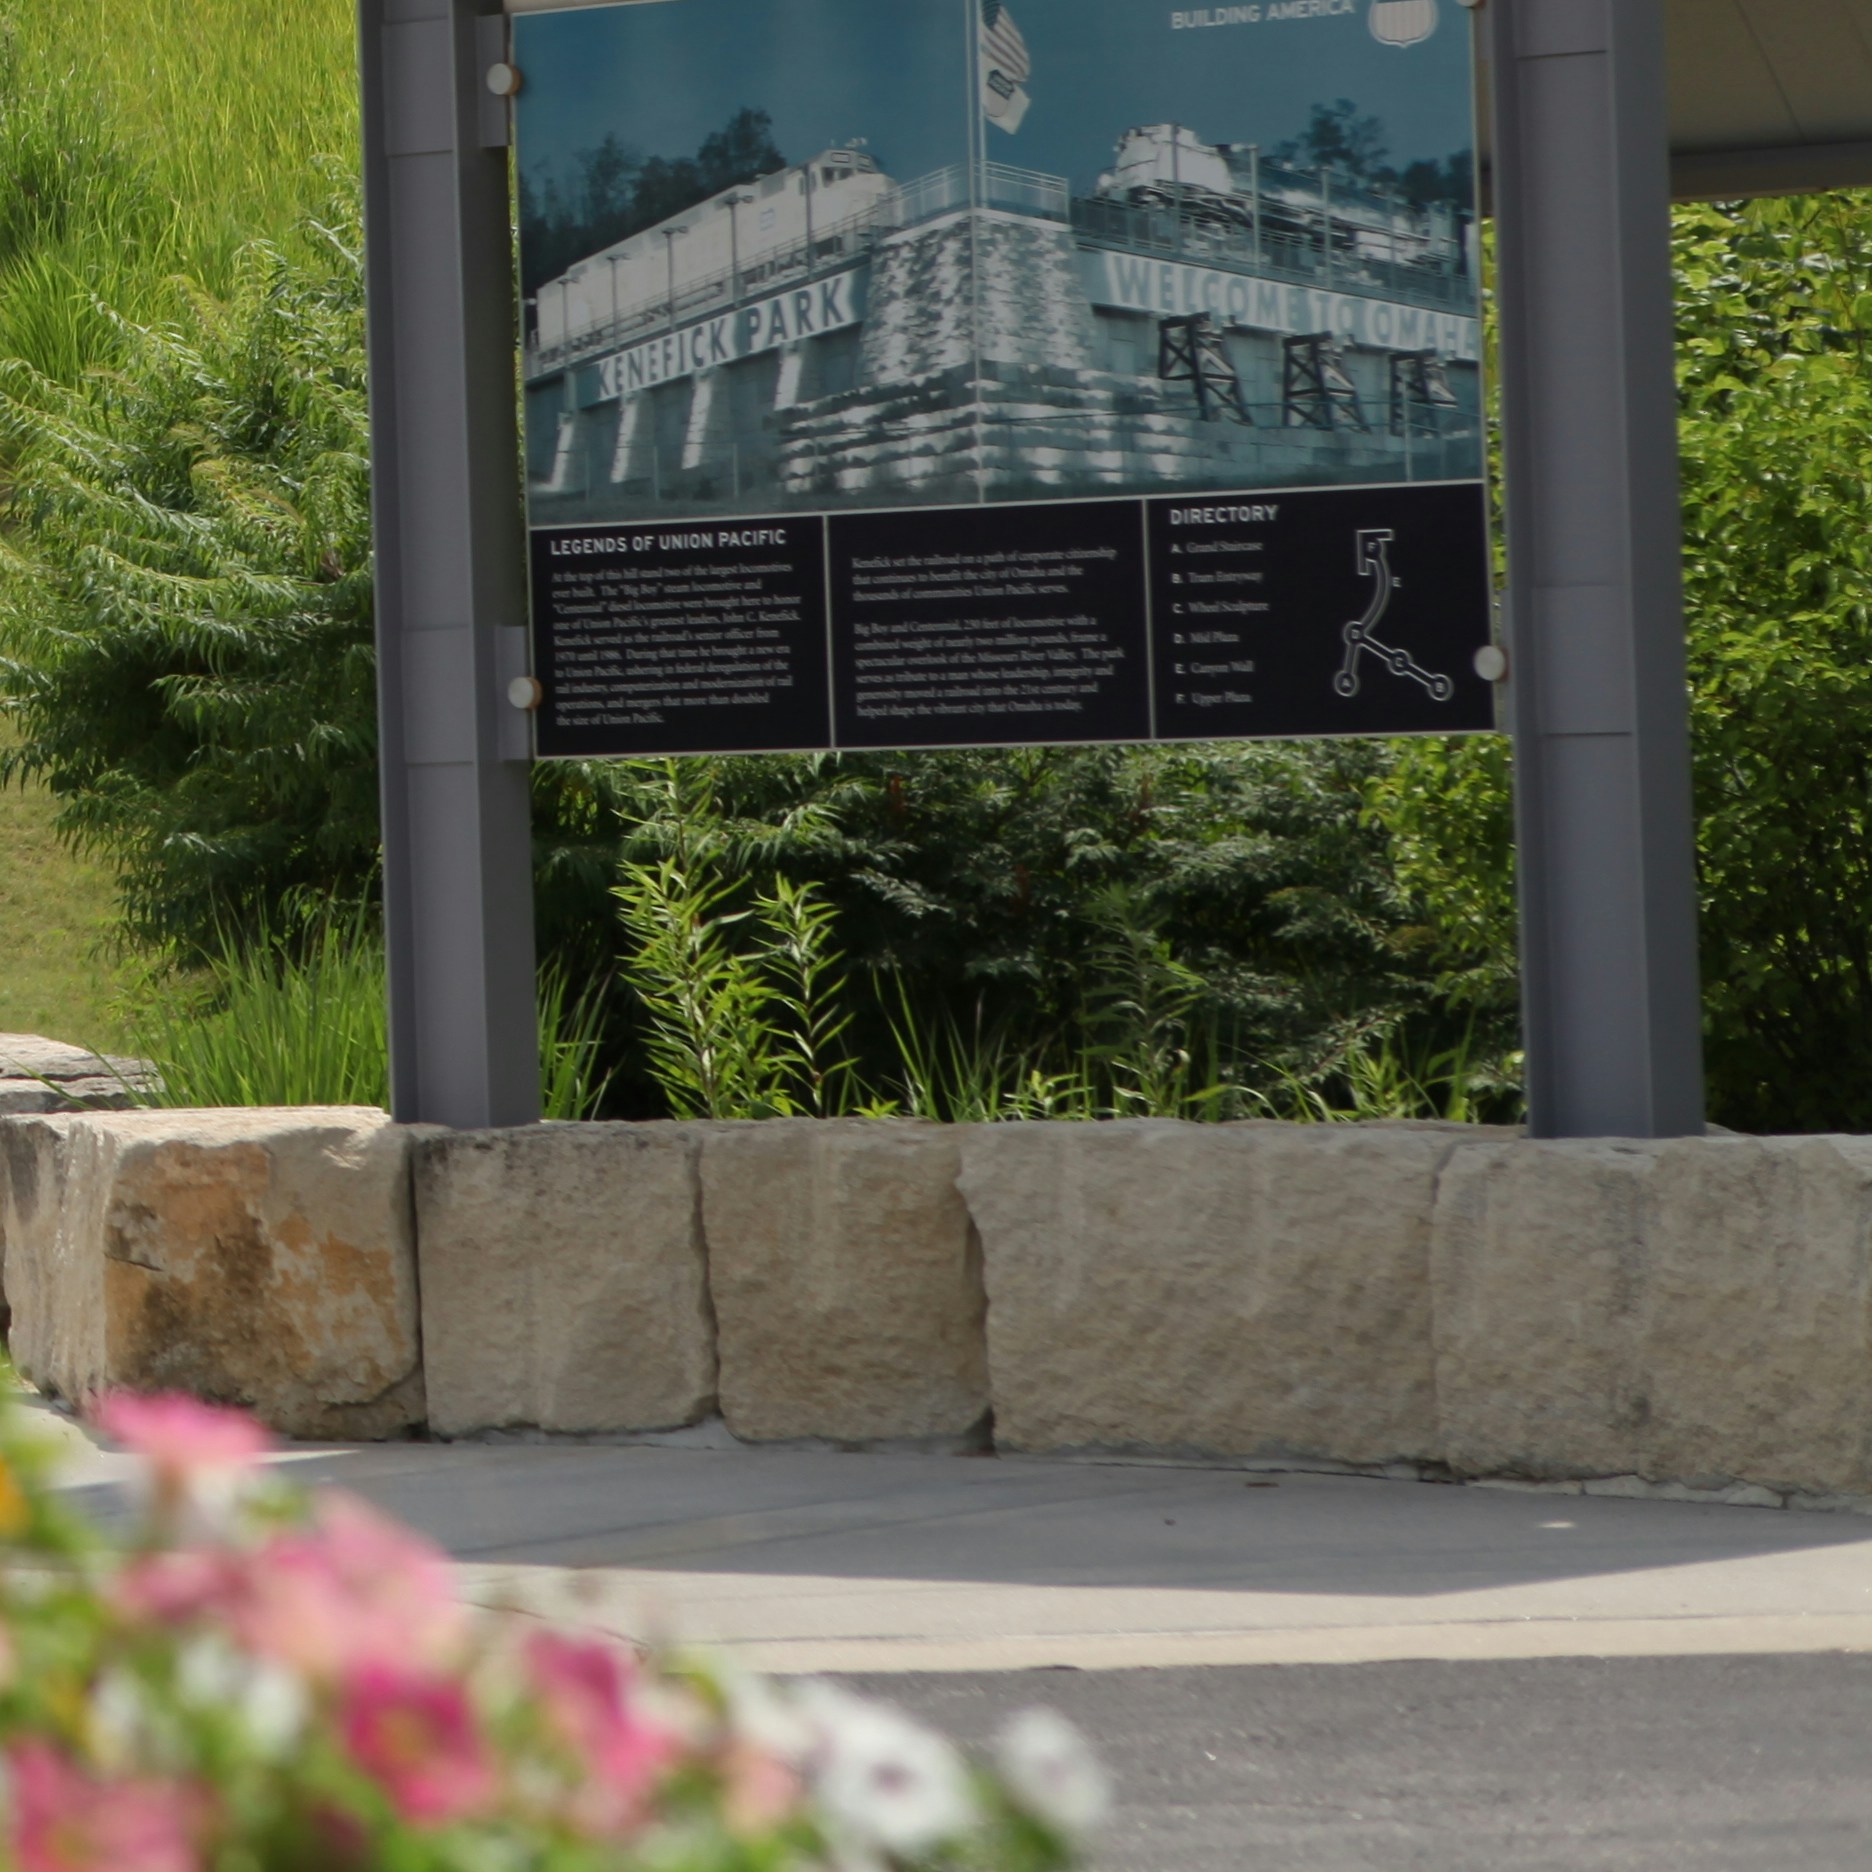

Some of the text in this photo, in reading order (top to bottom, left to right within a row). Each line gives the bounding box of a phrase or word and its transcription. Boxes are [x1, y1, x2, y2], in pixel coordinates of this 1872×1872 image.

[1171, 5, 1261, 29] BUILDING
[1115, 257, 1303, 324] WELCOME
[1314, 293, 1357, 331] TO
[597, 278, 844, 398] KENEFICK PARK
[1170, 504, 1279, 525] DIRECTORY
[550, 529, 787, 555] LEGENDS OF UNION PACIFIC
[1368, 542, 1377, 552] F
[1392, 577, 1402, 587] E
[1351, 629, 1360, 639] D
[1396, 657, 1404, 667] C
[1342, 678, 1351, 688] A
[1436, 682, 1445, 692] B
